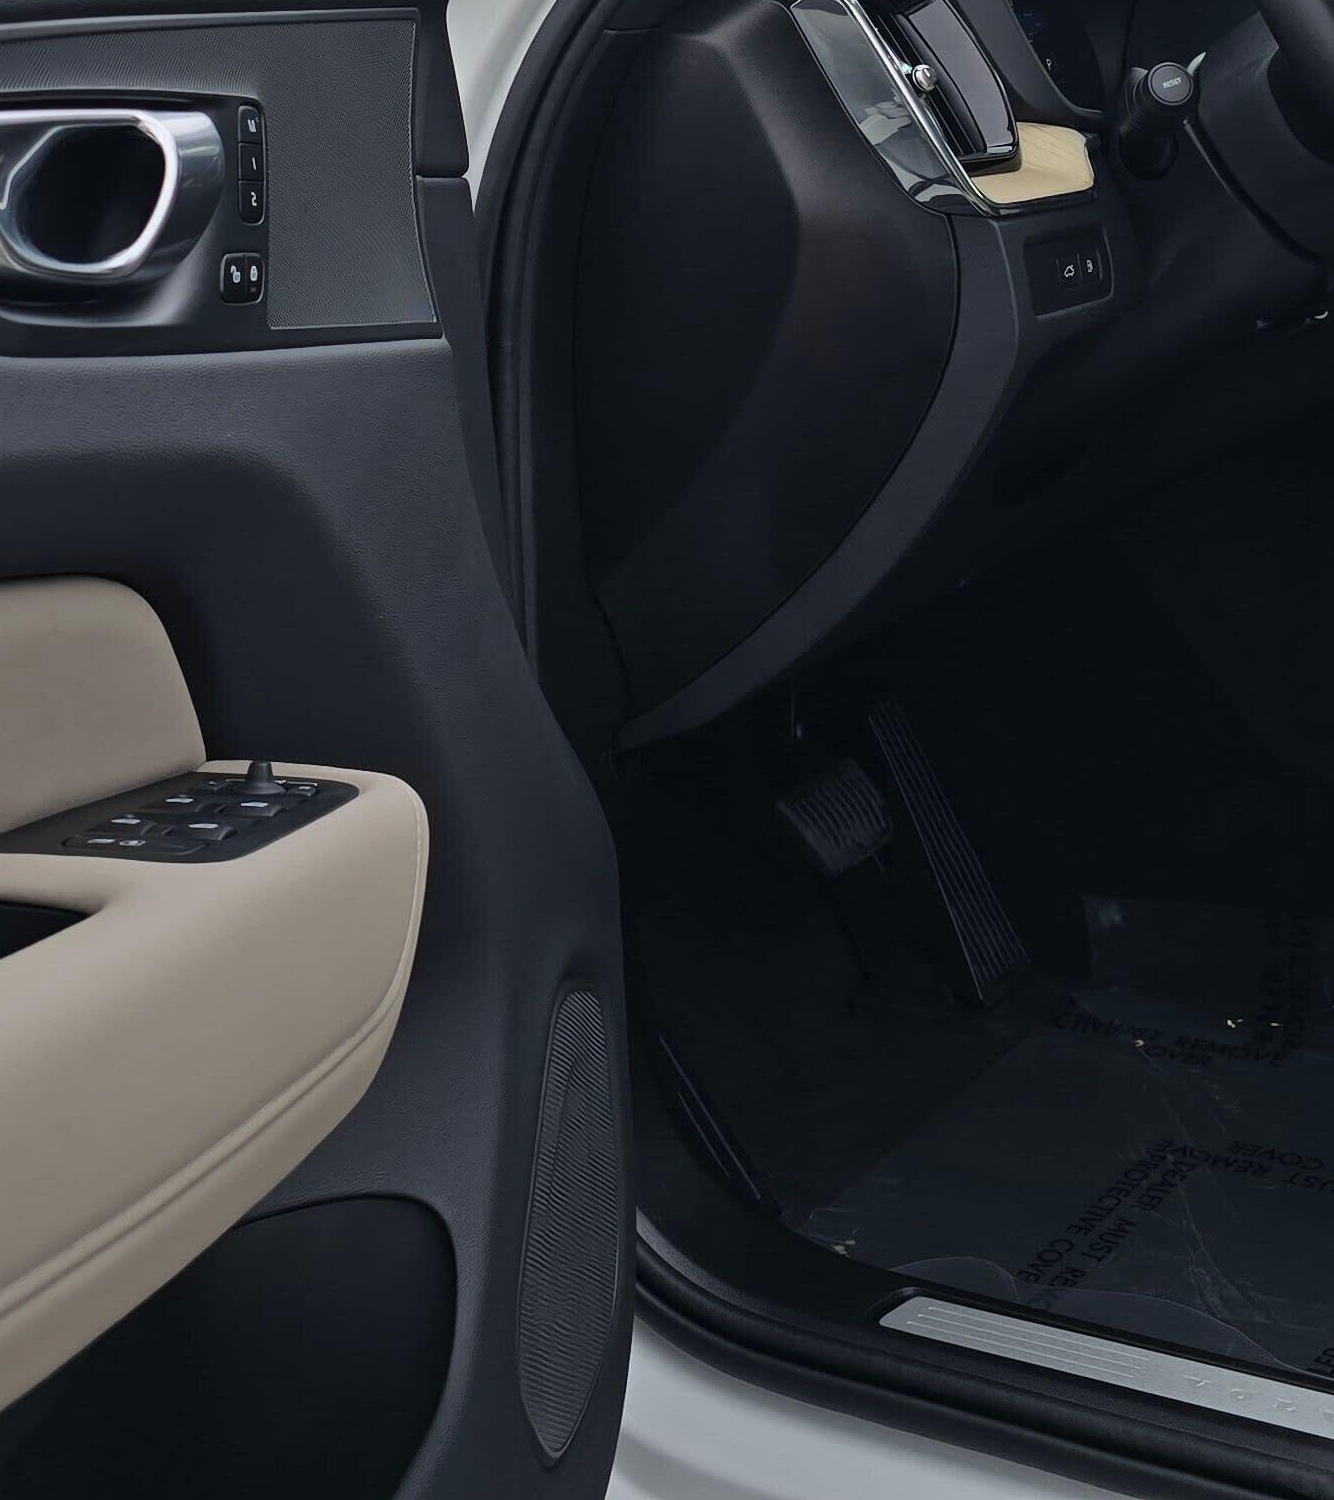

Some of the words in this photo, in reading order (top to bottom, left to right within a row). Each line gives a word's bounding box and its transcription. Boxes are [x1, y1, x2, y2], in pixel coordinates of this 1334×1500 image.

[250, 192, 258, 207] 2
[1227, 1138, 1324, 1171] COVER
[1081, 1217, 1138, 1263] MUST
[1016, 1237, 1075, 1284] COVE
